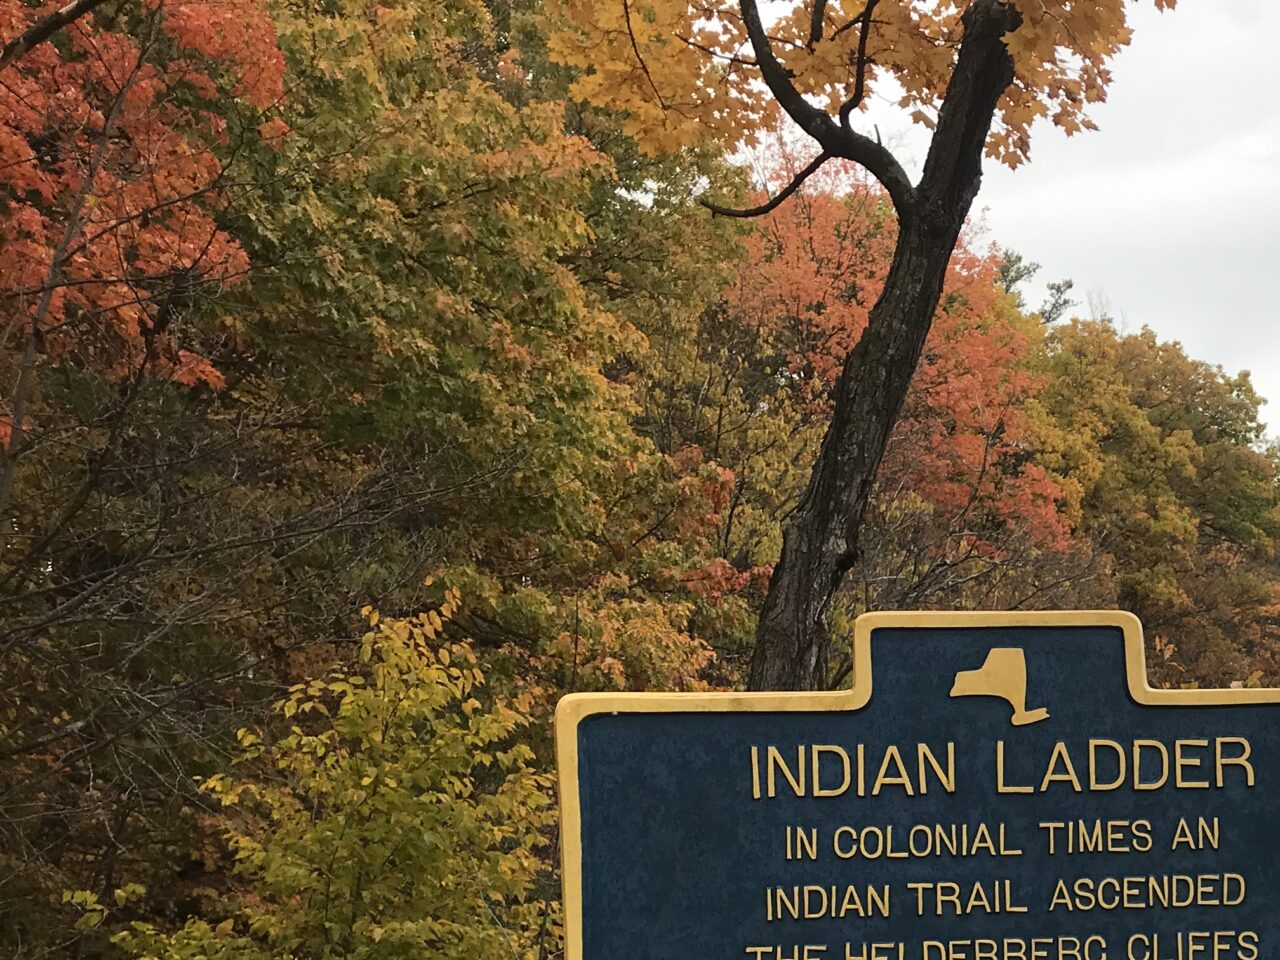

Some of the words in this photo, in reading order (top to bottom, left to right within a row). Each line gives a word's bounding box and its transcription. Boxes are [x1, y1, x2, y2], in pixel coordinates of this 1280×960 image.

[751, 742, 955, 799] INDIAN
[996, 736, 1255, 793] LADDER
[786, 826, 817, 860] IN
[833, 823, 1023, 859] COLONIAL
[1039, 819, 1153, 854] TIMES
[1171, 816, 1219, 850] AN
[766, 884, 890, 921] INDIAN
[906, 879, 1028, 915] TRAIL
[1049, 873, 1246, 911] ASCENDED
